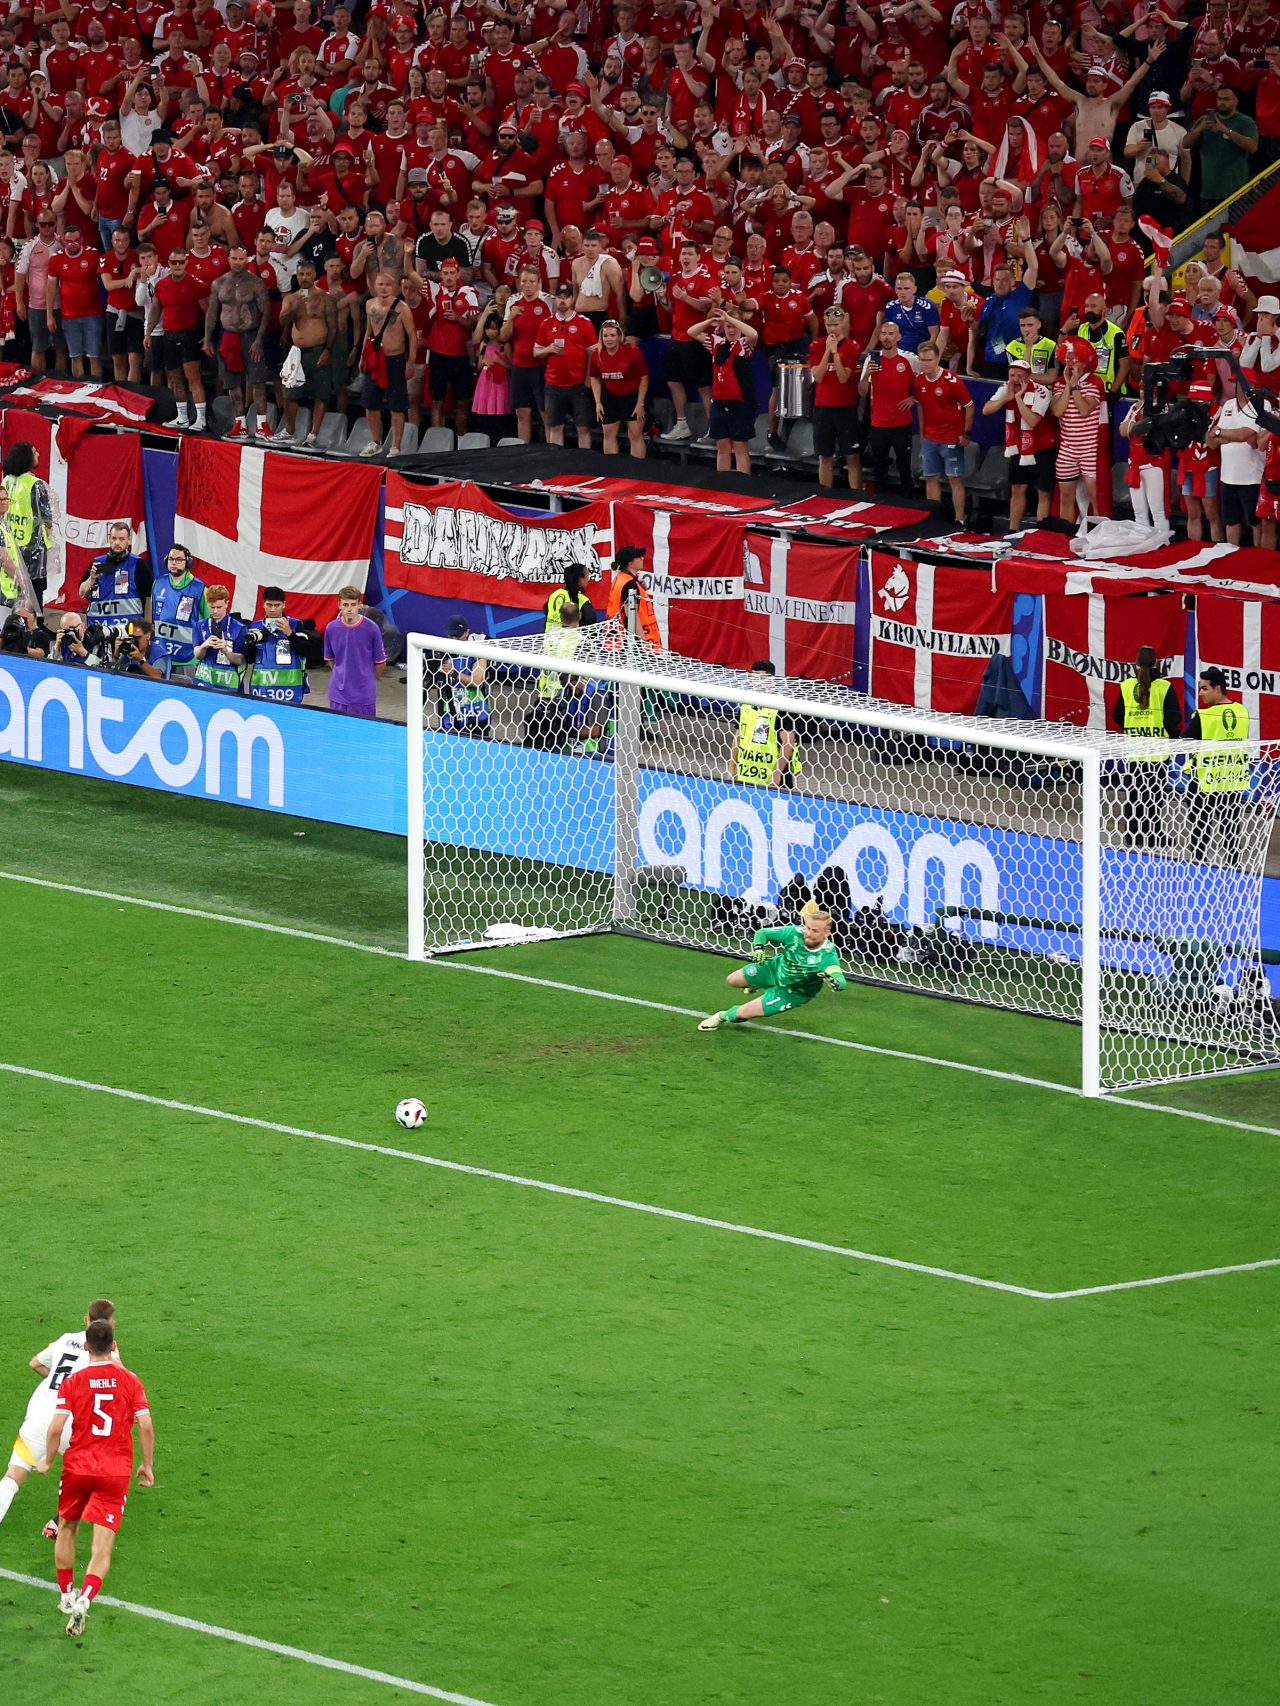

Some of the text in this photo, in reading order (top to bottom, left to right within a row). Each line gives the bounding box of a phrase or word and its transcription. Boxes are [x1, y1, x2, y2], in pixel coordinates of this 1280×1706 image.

[97, 601, 120, 615] ICT
[793, 600, 844, 622] FINEST
[158, 623, 178, 638] CT
[878, 620, 1001, 655] KRONJYLLAND
[215, 671, 233, 684] TV
[261, 670, 279, 684] TV
[1246, 671, 1275, 692] ON
[639, 786, 1000, 939] antom
[49, 1353, 79, 1390] 6
[92, 1393, 114, 1437] 5
